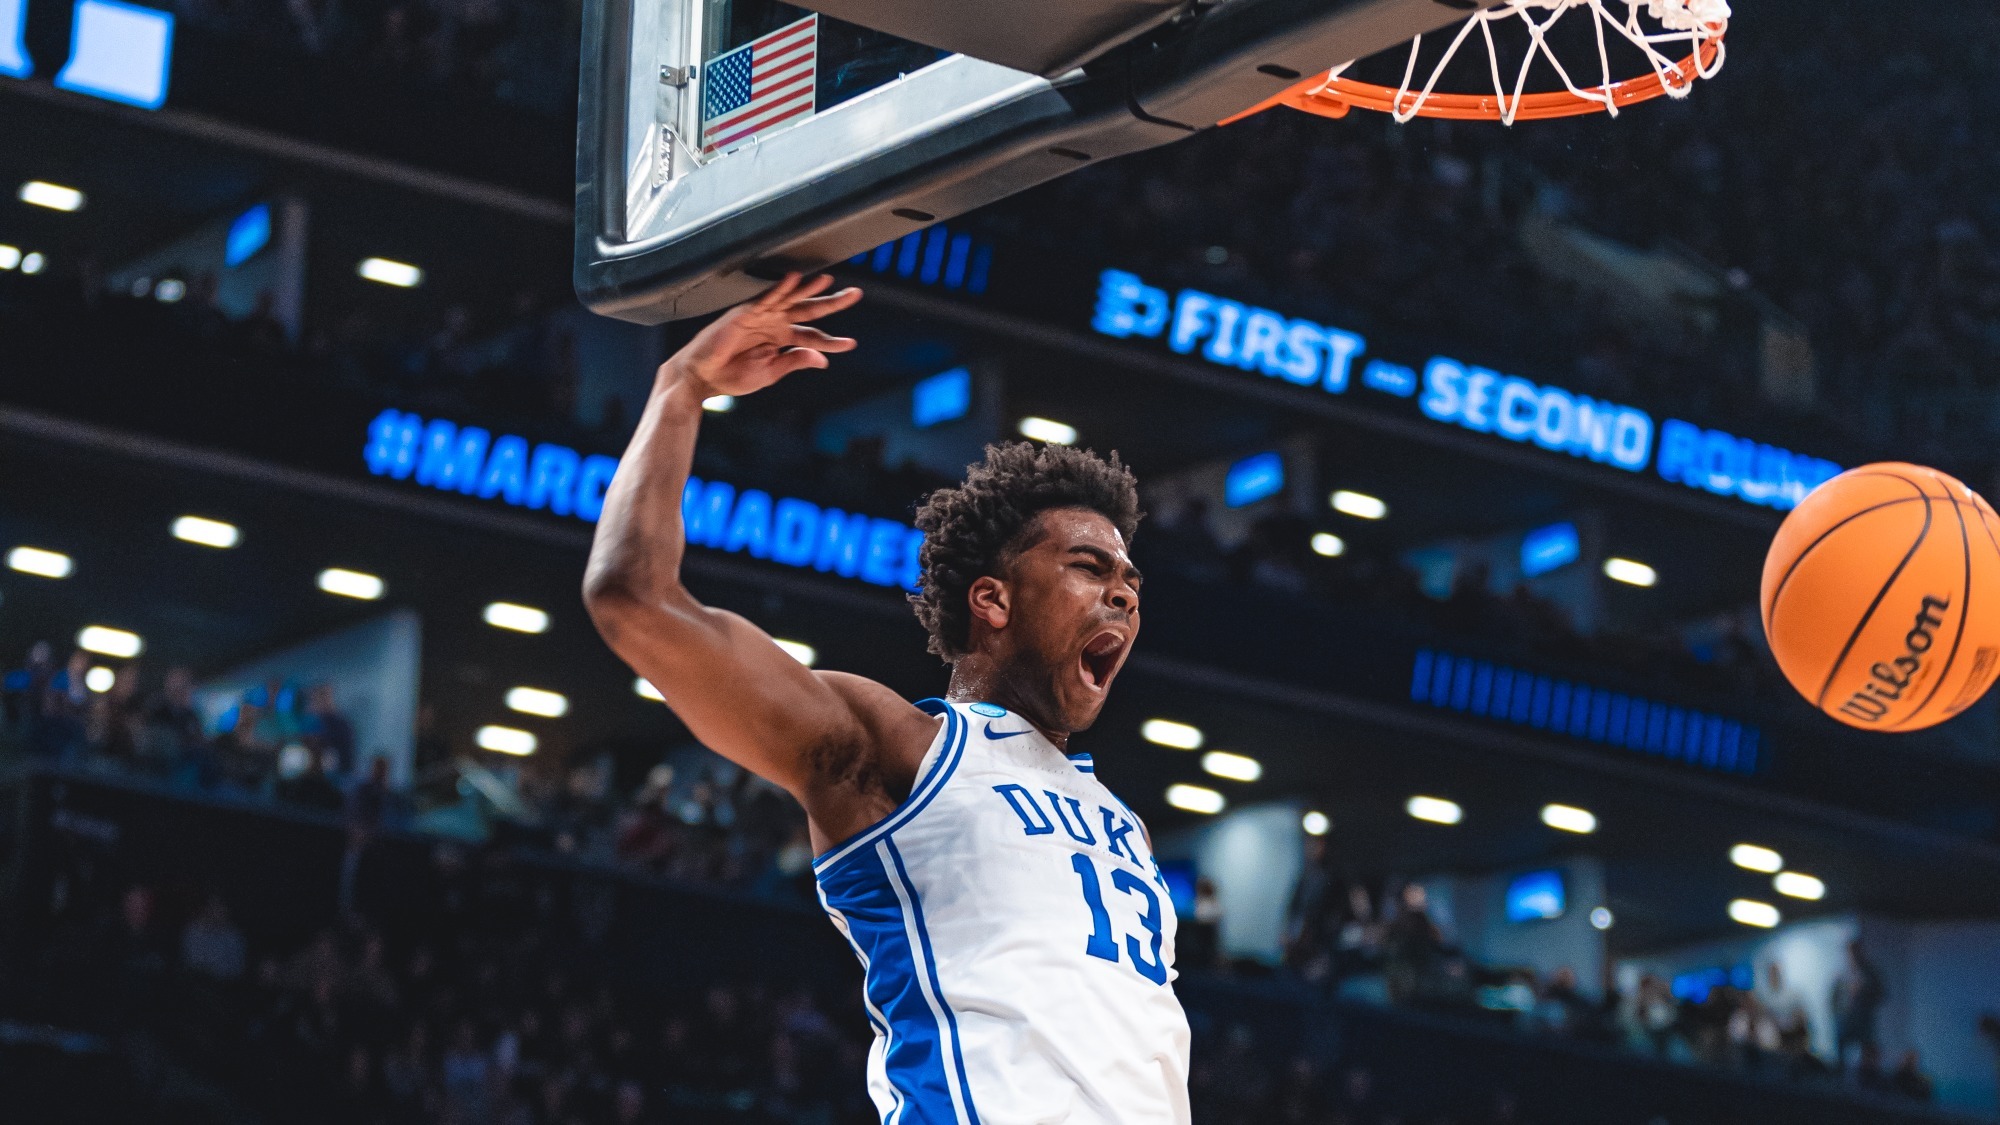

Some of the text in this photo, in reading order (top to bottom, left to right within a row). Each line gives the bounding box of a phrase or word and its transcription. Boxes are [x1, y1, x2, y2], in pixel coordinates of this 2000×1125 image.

[1168, 289, 1366, 394] FIRST
[1418, 355, 1654, 472] SECOND
[363, 408, 621, 523] #MARC
[1839, 590, 1951, 722] Wilson
[1071, 852, 1167, 986] 13
